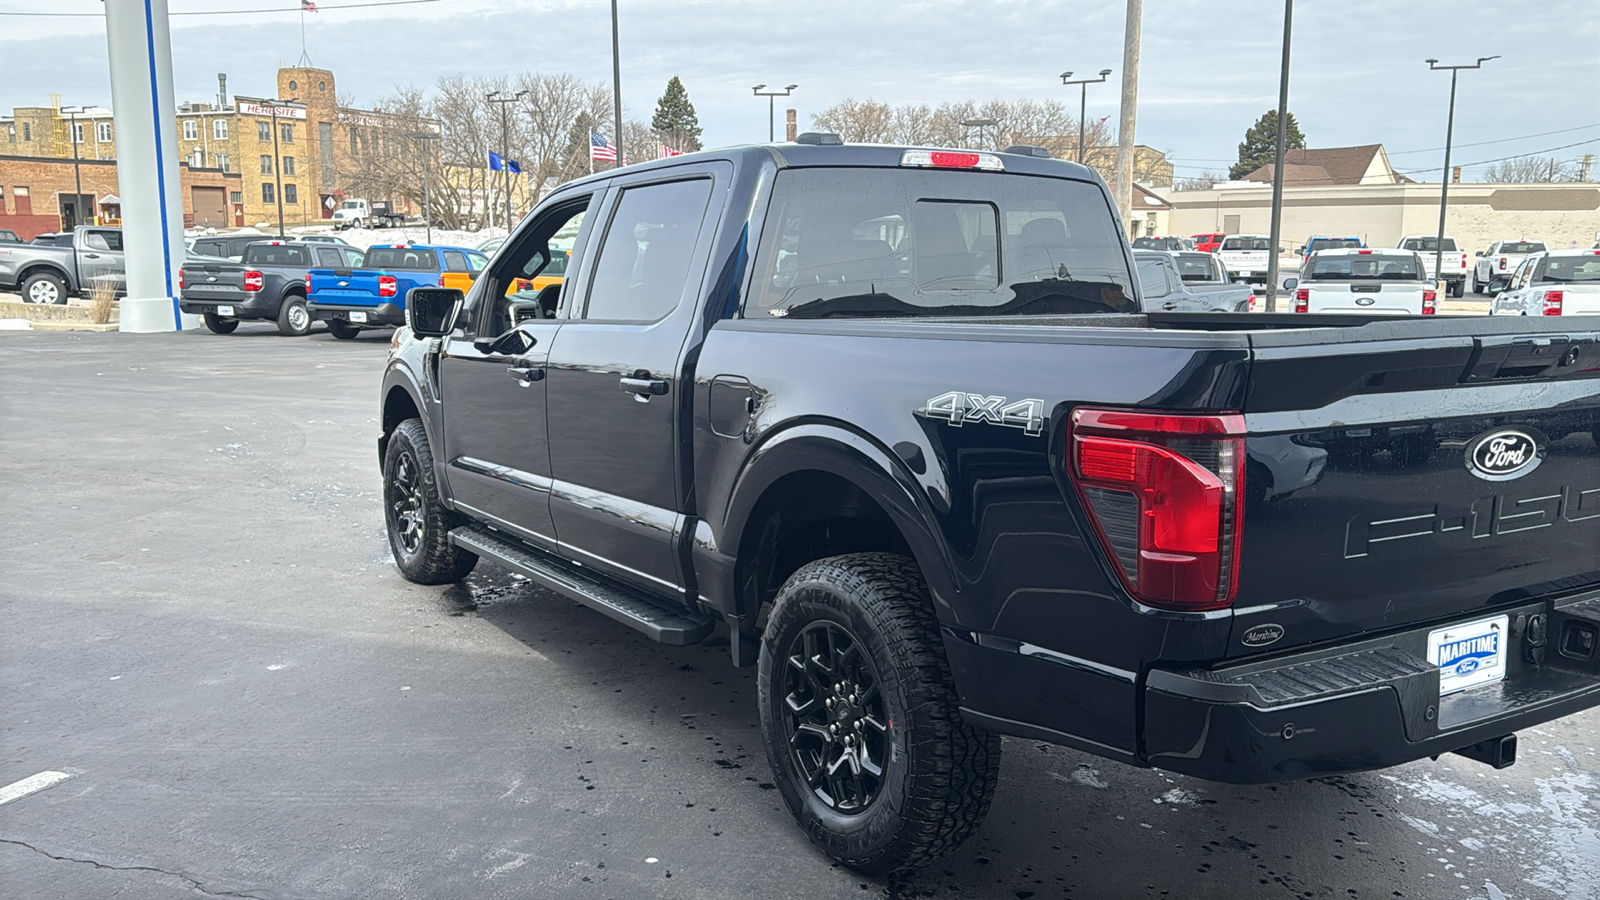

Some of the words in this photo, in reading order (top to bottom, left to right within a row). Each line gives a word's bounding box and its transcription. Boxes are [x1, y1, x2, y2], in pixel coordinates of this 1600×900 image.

[247, 104, 298, 118] HERESITE
[1485, 436, 1527, 468] Ford
[1440, 633, 1497, 667] MARITIME
[1458, 660, 1478, 674] Ford
